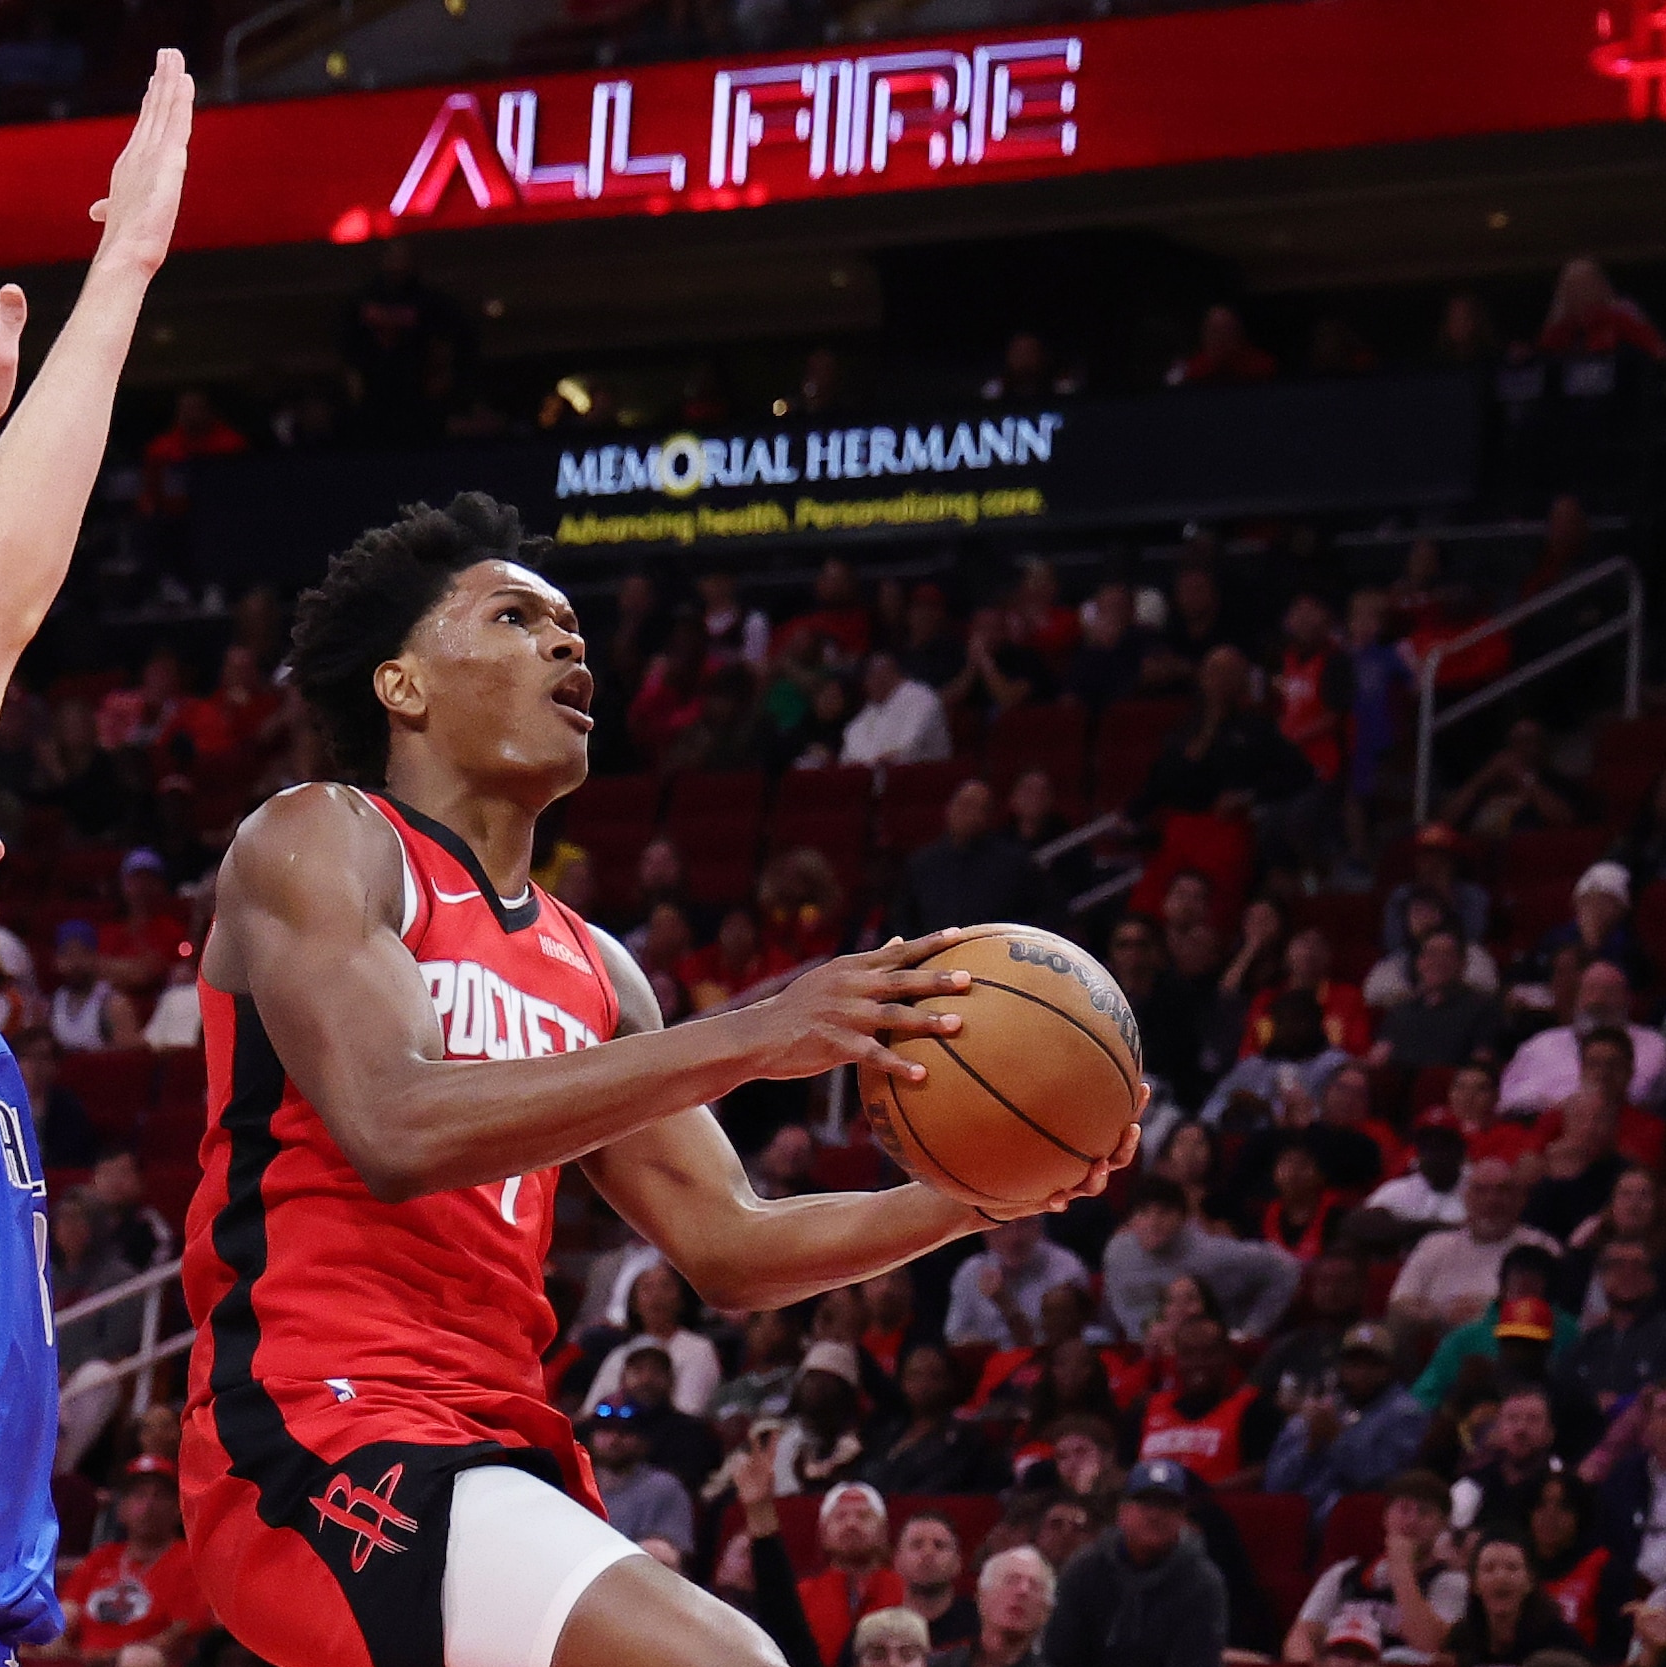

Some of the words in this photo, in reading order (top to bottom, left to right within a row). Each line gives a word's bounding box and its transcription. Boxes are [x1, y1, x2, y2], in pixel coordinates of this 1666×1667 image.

[390, 78, 686, 217] ALL
[708, 37, 1082, 188] FIRE
[555, 432, 800, 500] MEMORIAL
[805, 412, 1055, 482] HERMANN
